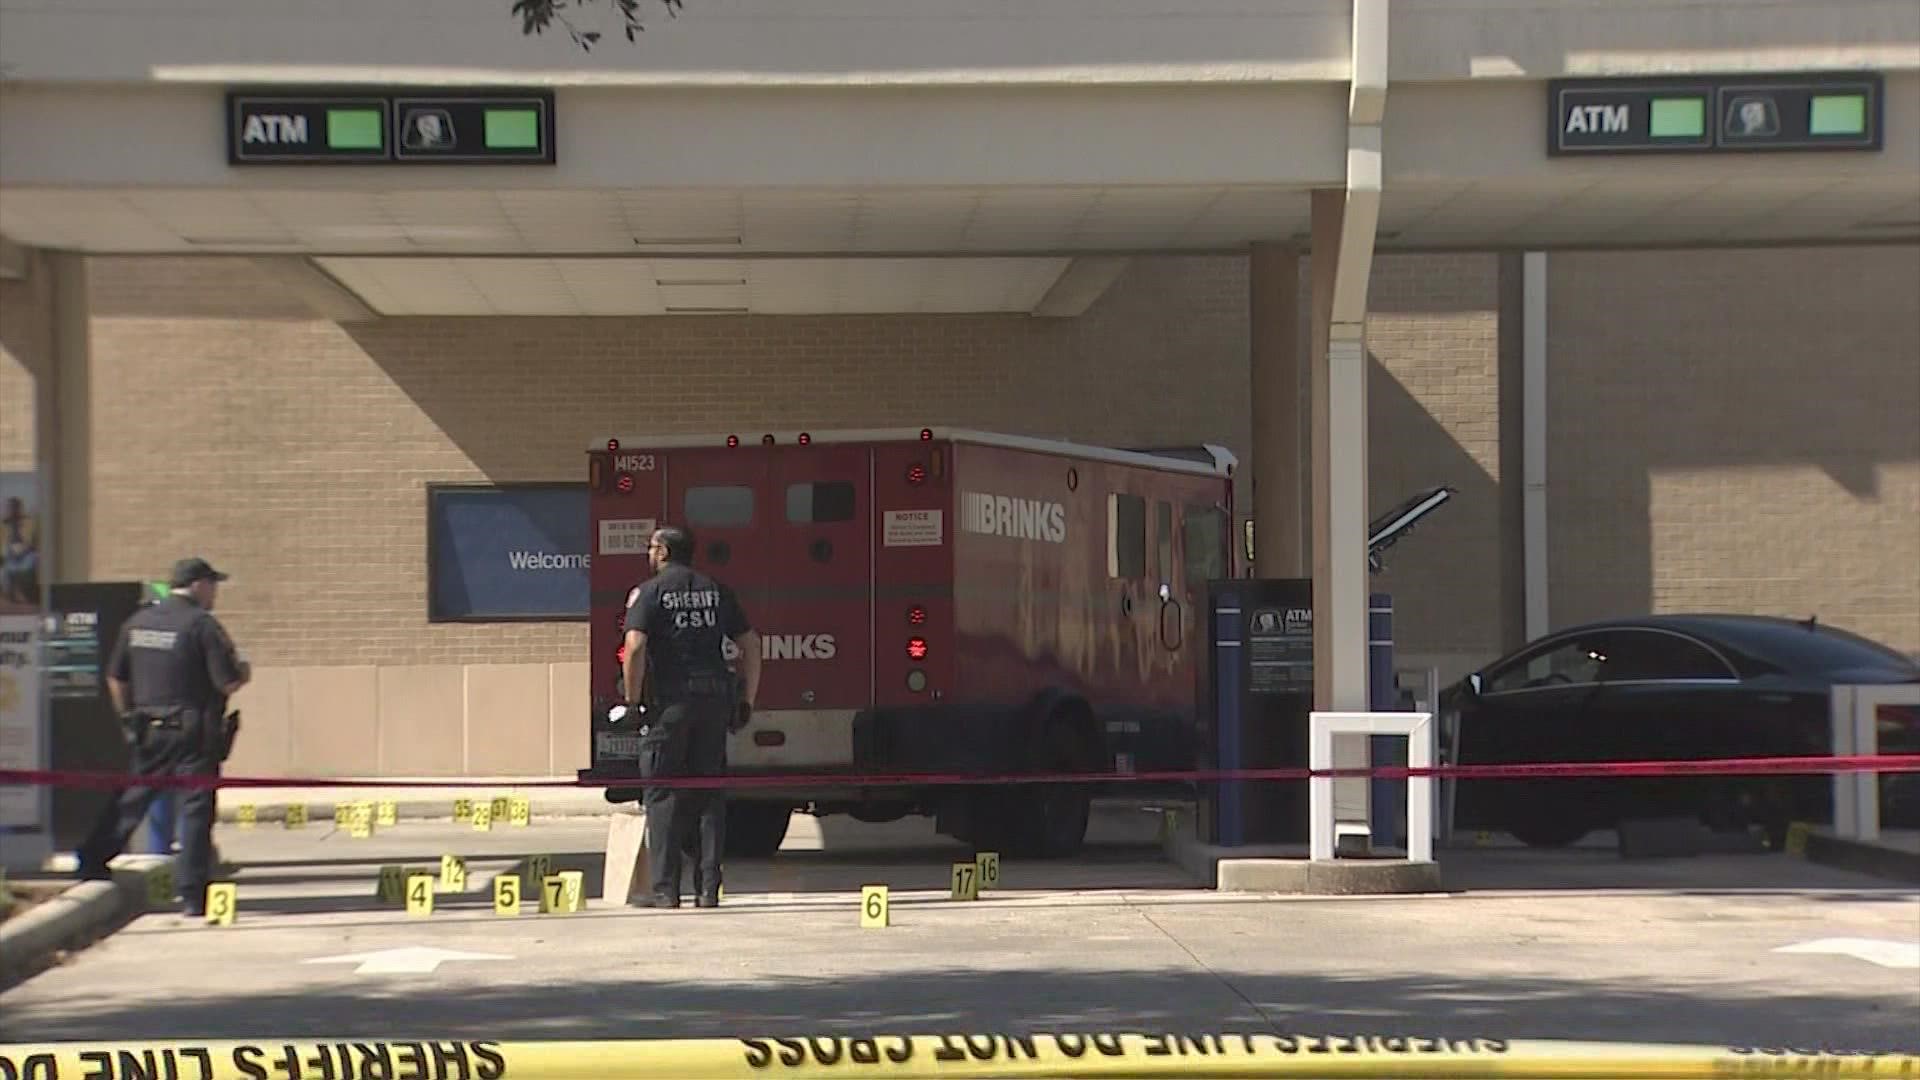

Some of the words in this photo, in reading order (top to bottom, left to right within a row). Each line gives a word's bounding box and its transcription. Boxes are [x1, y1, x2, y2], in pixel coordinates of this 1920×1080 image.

[243, 115, 308, 144] ATM
[1566, 105, 1629, 133] ATM
[614, 455, 655, 471] 141523
[896, 512, 928, 521] NOTICE
[980, 493, 1066, 543] BRINKS
[509, 551, 591, 569] Welcome
[675, 609, 716, 628] CSU
[721, 634, 836, 660] BINKS
[446, 860, 463, 884] 12
[956, 868, 972, 895] 17
[981, 858, 997, 881] 16
[213, 890, 228, 916] 3
[411, 881, 426, 907] 4
[500, 881, 515, 907] 5
[547, 881, 562, 907] 7
[866, 892, 881, 919] 6
[78, 1047, 213, 1080] LINE
[233, 1040, 506, 1080] SHERIFFS
[740, 1034, 914, 1068] CROSS
